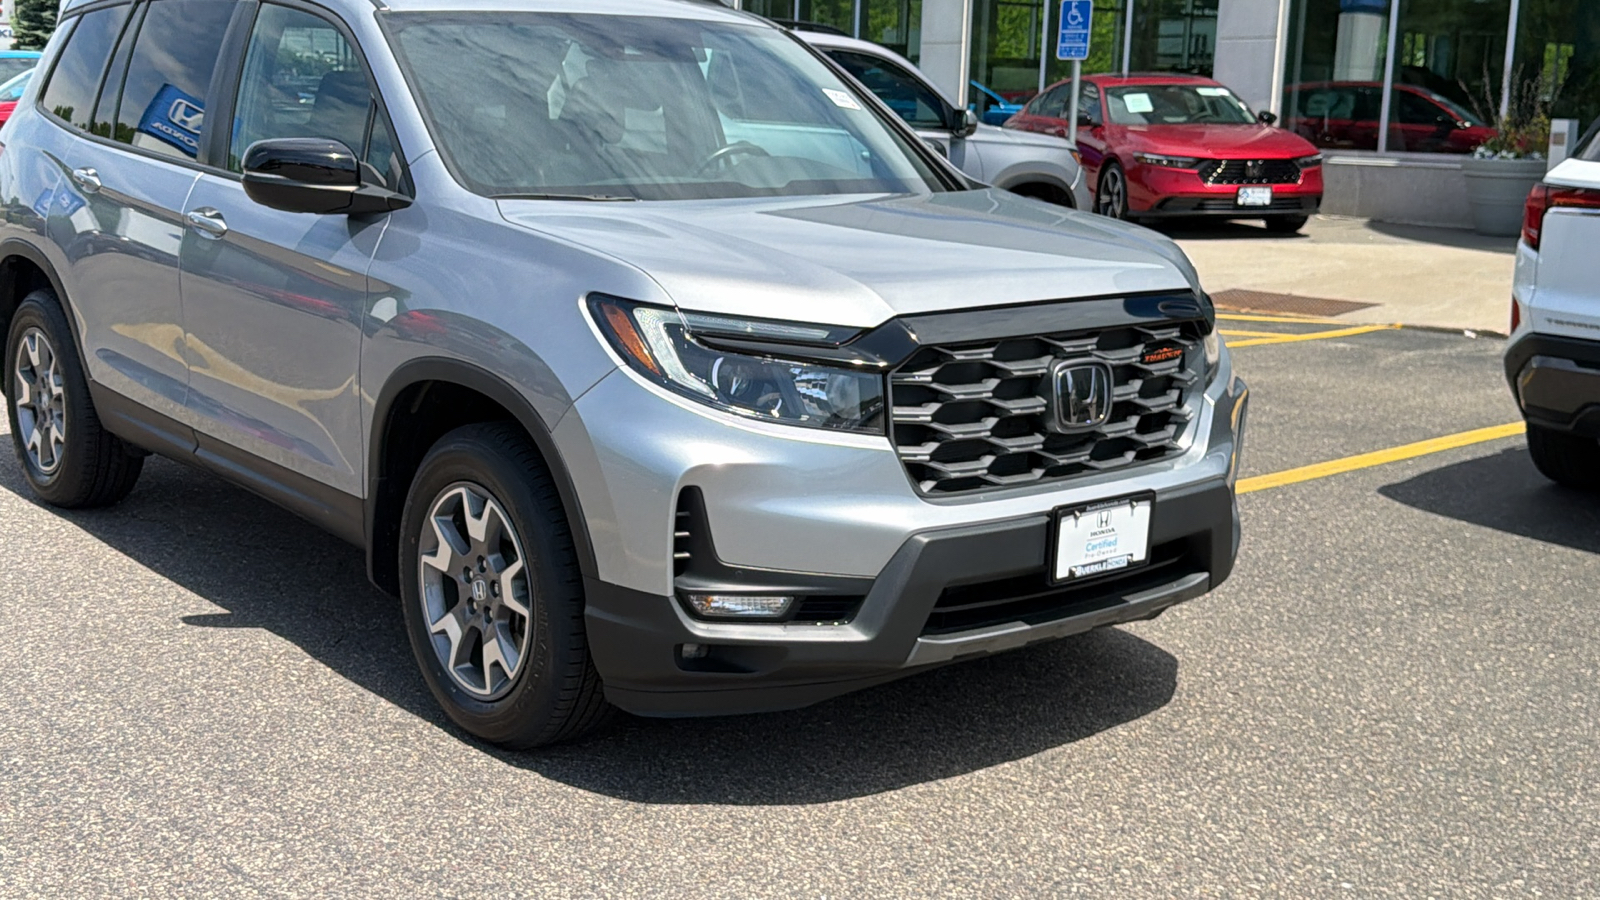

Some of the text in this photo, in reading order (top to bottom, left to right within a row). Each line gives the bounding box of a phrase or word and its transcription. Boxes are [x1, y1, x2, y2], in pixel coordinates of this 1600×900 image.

[1090, 527, 1115, 537] HONDA
[1086, 537, 1118, 552] Certified
[1085, 548, 1117, 558] Pre-Owned
